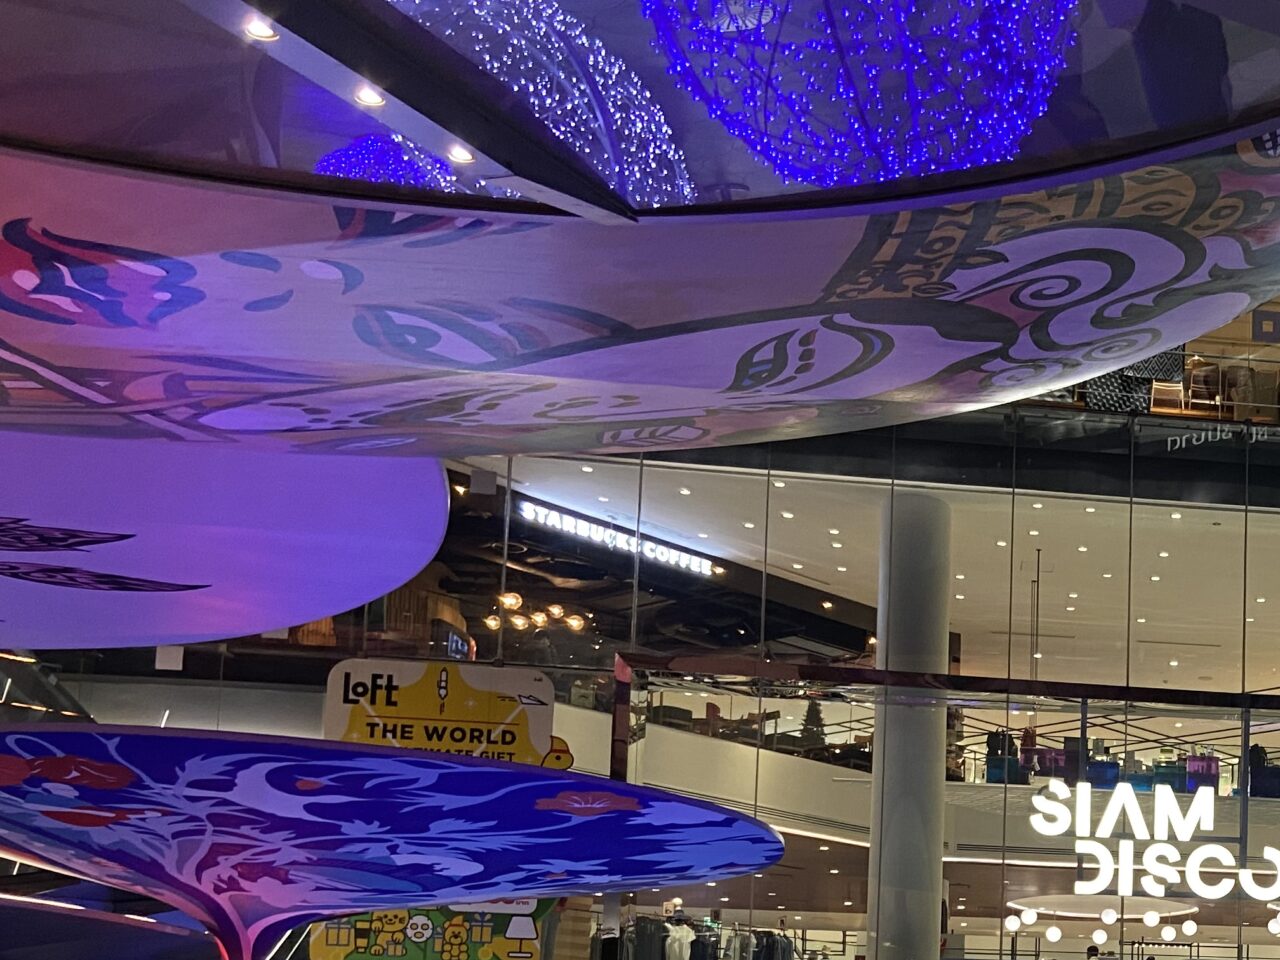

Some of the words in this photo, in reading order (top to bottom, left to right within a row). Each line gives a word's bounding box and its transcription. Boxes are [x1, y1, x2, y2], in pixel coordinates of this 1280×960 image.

[520, 501, 641, 554] STARBUCKS
[641, 541, 714, 576] COFFEE
[365, 722, 414, 740] THE
[424, 725, 517, 746] WORLD
[1029, 778, 1216, 842] SIAM
